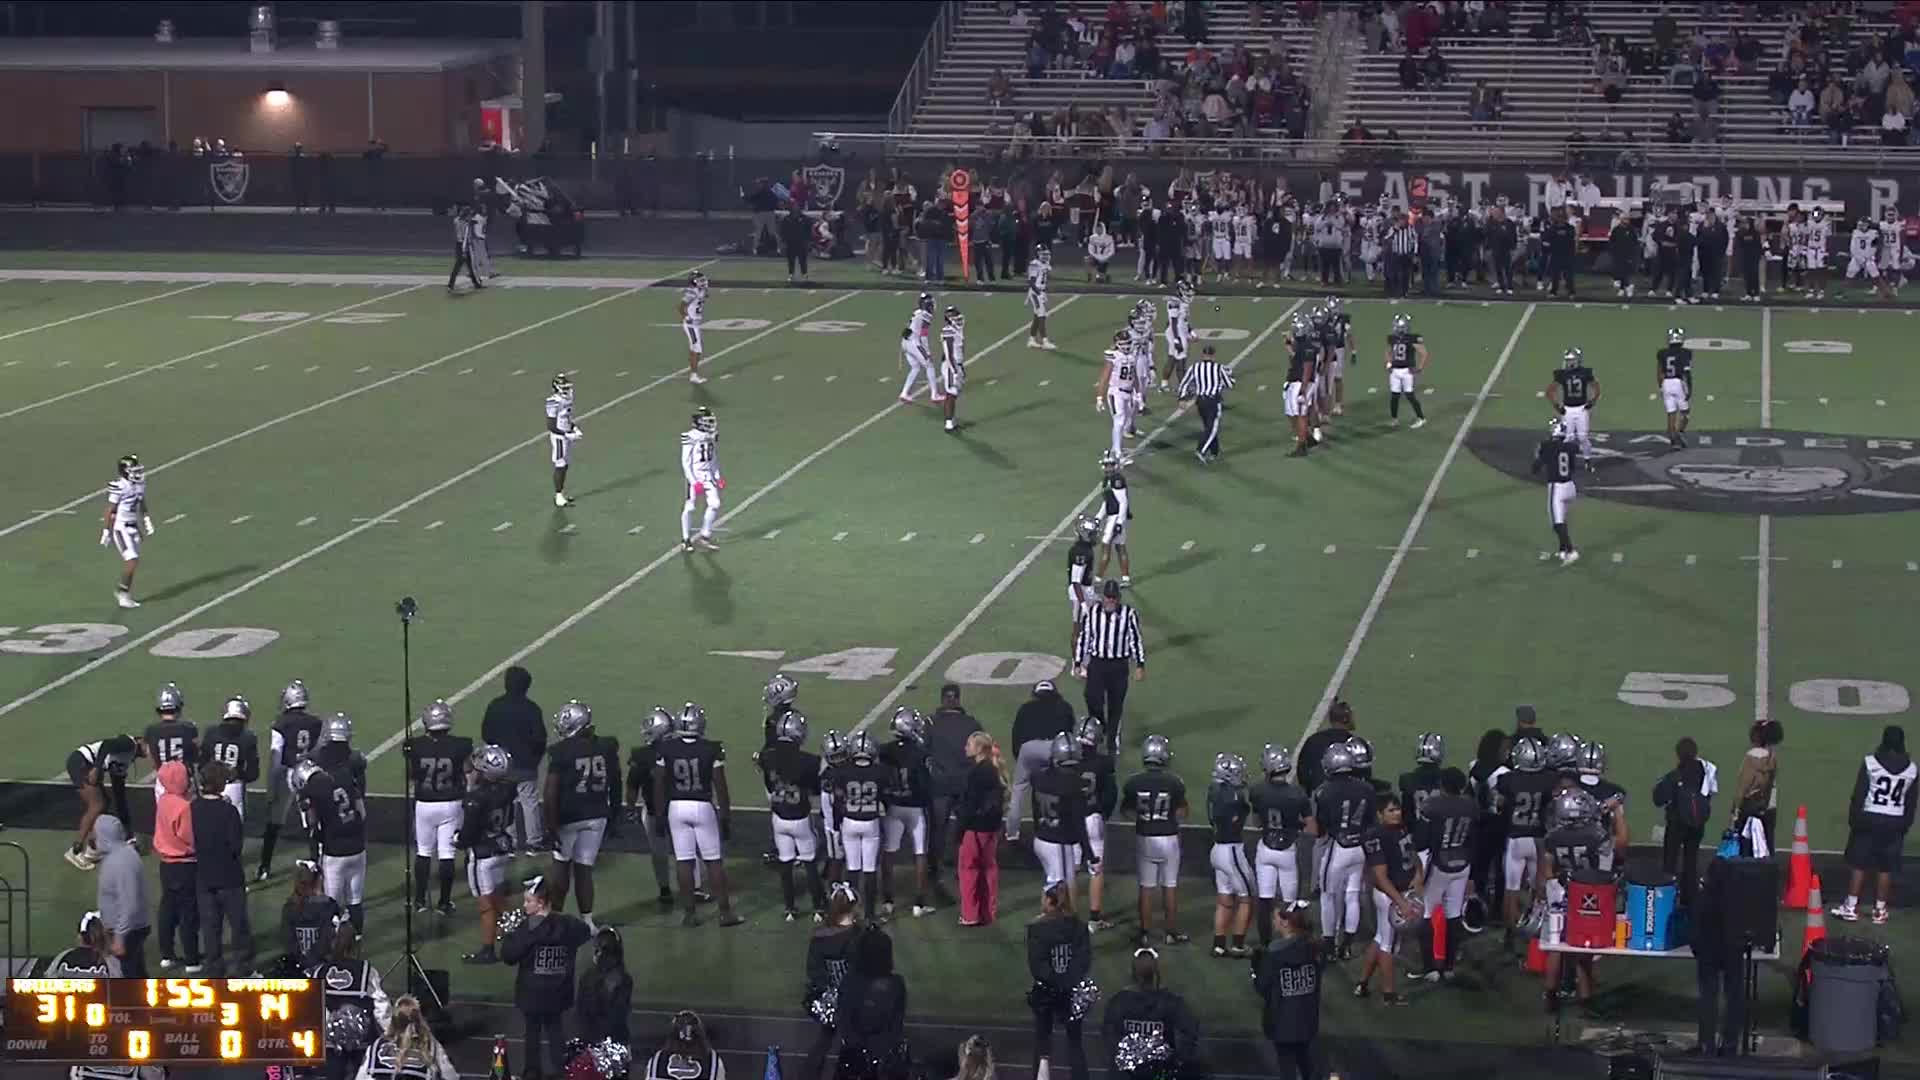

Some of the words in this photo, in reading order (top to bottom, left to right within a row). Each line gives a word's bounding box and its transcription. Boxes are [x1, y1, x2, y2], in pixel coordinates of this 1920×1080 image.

[1666, 356, 1676, 377] 5
[1558, 452, 1570, 477] 8
[419, 757, 454, 792] 72
[575, 755, 607, 793] 79
[672, 757, 703, 792] 91
[1873, 775, 1906, 807] 24
[333, 787, 355, 824] 2
[1511, 791, 1543, 826] 21
